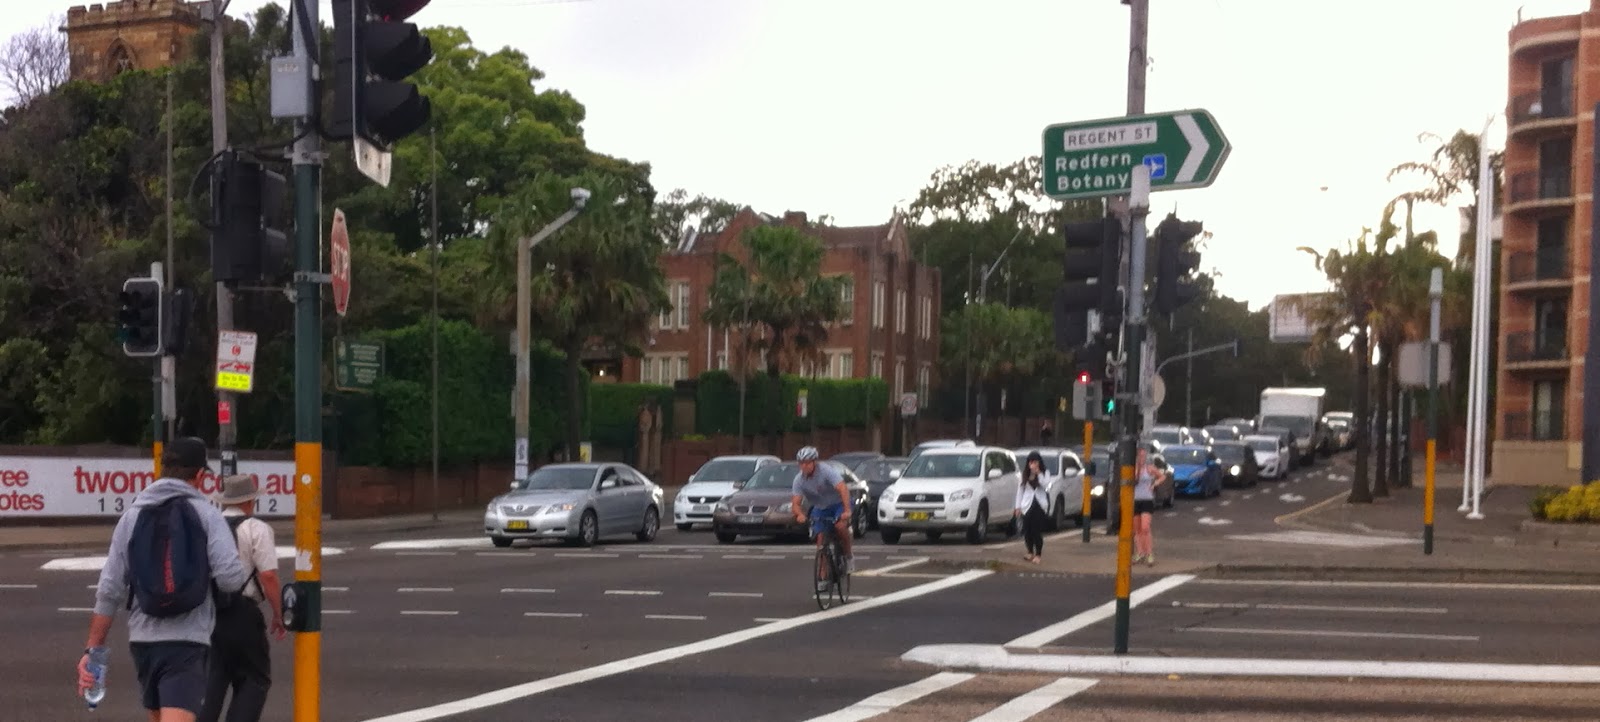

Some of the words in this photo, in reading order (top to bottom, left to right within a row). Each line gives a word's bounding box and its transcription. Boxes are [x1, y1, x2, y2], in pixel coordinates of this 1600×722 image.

[1068, 130, 1126, 146] REGENT
[1134, 127, 1152, 140] ST
[1055, 153, 1131, 172] Redfern
[1057, 172, 1129, 191] Botany
